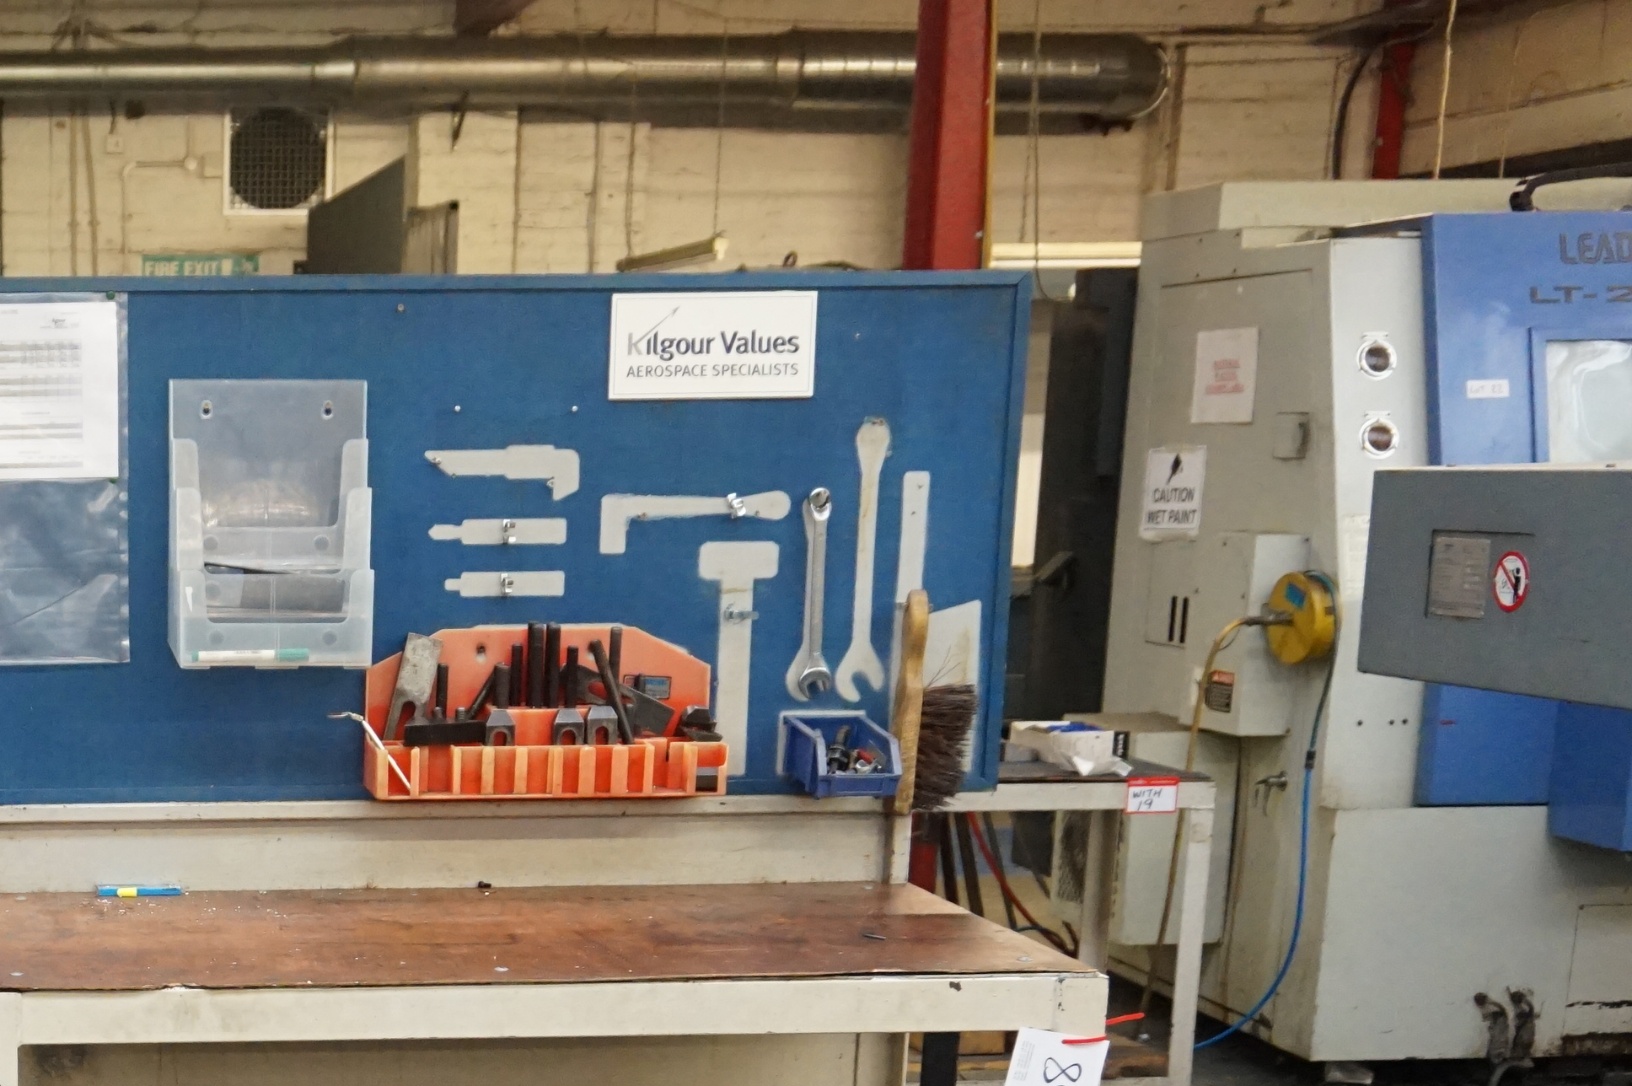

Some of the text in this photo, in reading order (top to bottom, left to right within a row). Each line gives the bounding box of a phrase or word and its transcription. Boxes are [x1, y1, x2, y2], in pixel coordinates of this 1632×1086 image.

[627, 330, 800, 361] Kilgour Values
[626, 363, 799, 378] AEROSPACE SPECIALISTS
[1152, 487, 1196, 503] CAUTION
[1147, 508, 1198, 525] WET PAINT
[1133, 788, 1163, 798] WITH
[1137, 799, 1153, 811] 19
